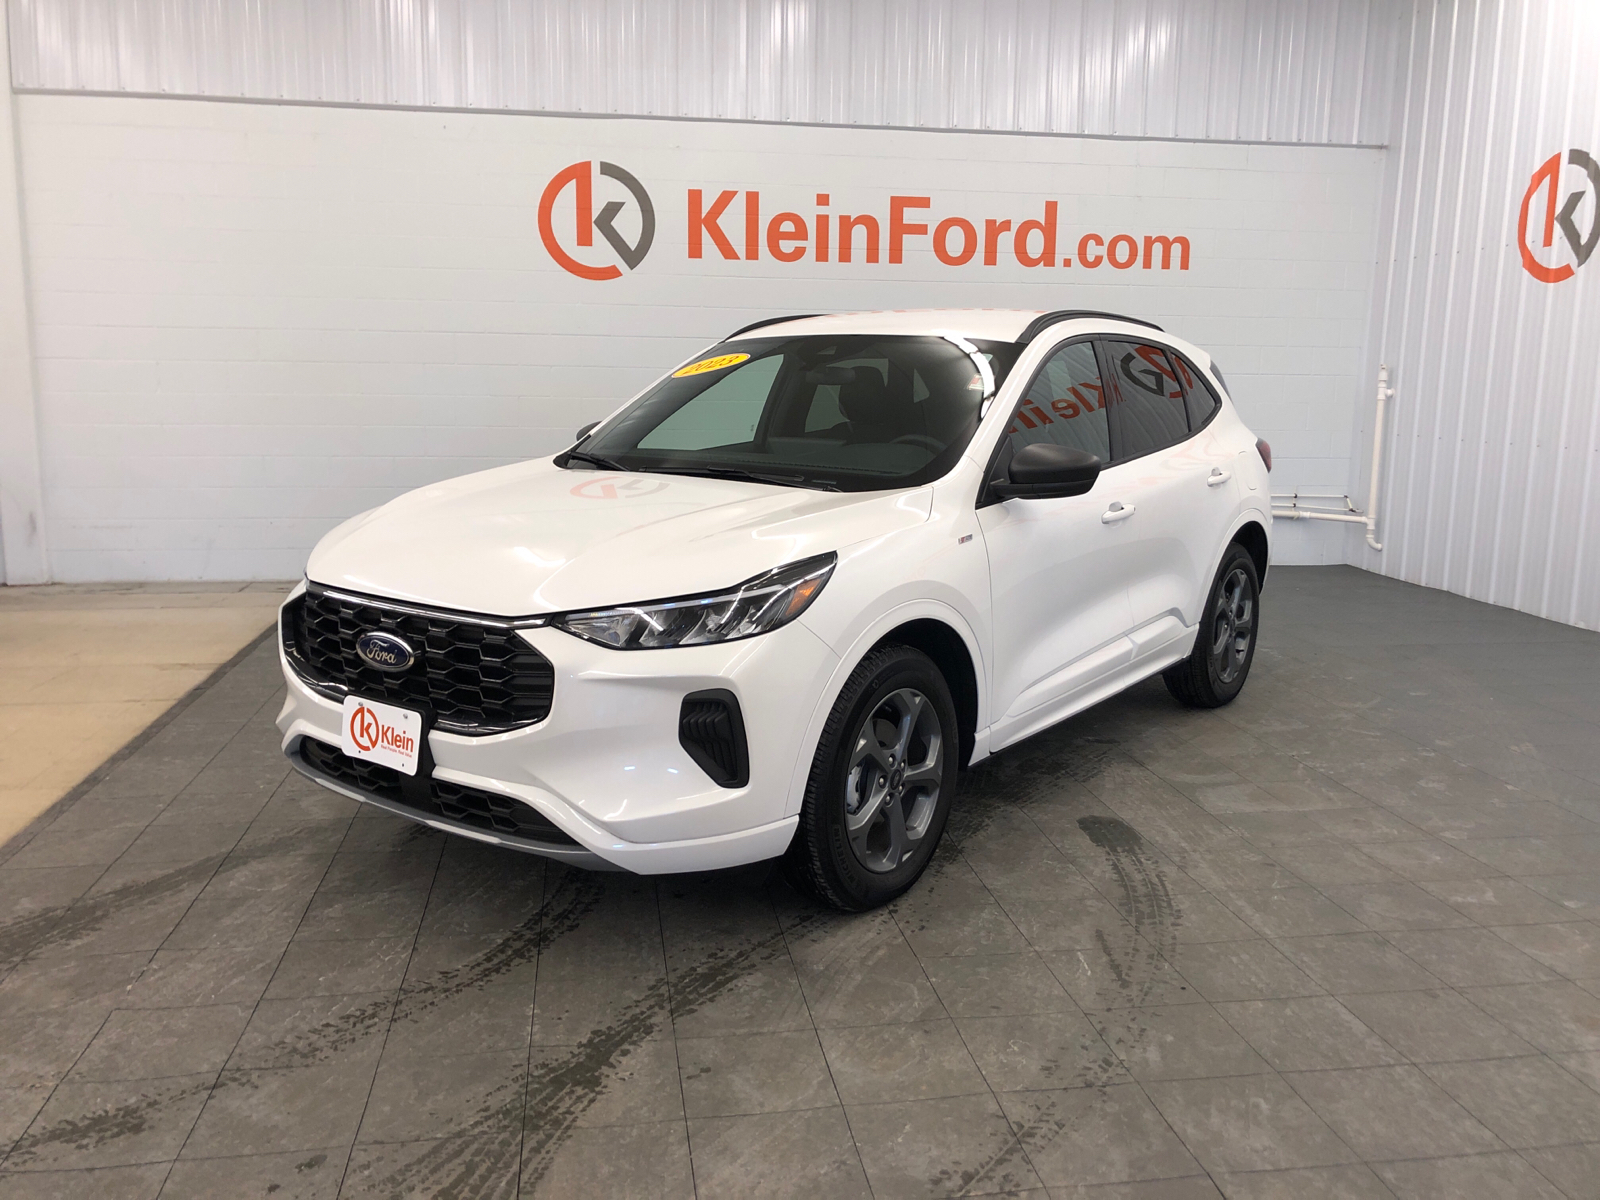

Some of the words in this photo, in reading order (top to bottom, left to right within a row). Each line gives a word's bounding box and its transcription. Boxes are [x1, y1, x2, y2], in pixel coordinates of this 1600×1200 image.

[687, 188, 1191, 271] KleinFord.com
[682, 355, 740, 375] 2023
[366, 639, 398, 664] Ford
[381, 724, 414, 753] Klein
